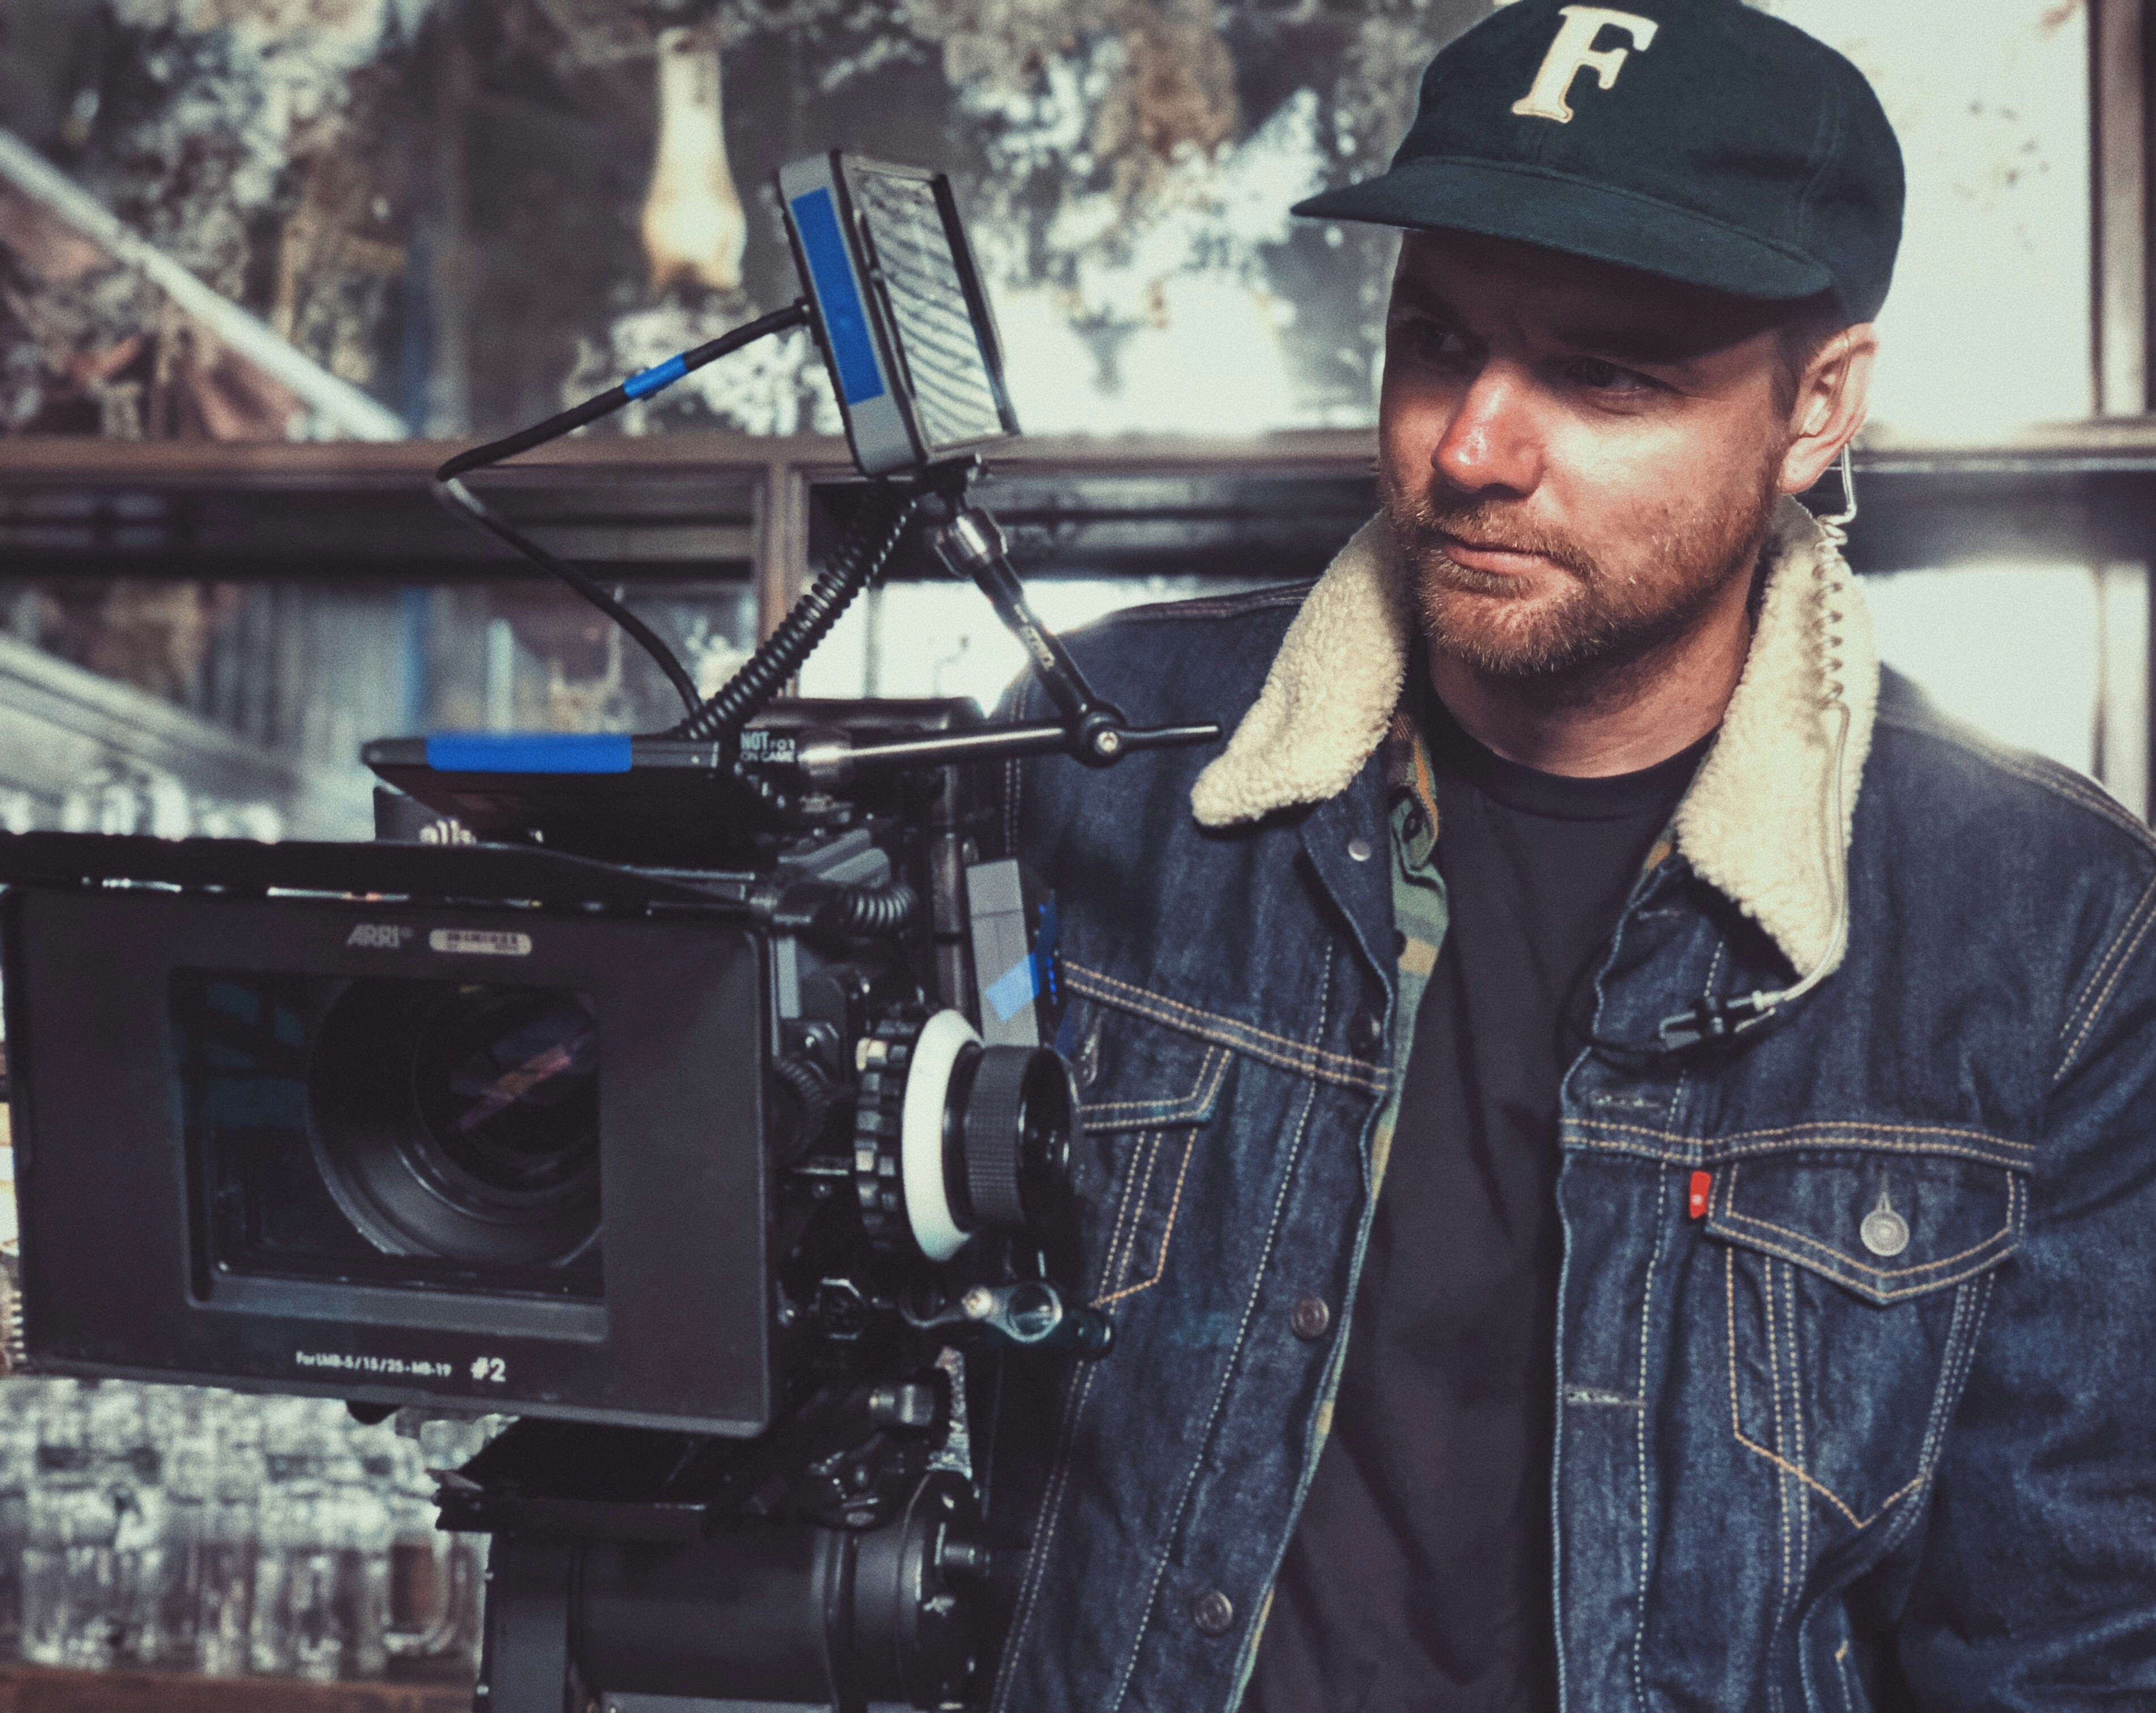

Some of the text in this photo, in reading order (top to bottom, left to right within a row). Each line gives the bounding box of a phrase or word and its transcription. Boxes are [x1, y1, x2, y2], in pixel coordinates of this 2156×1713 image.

[1511, 5, 1659, 123] F
[347, 924, 401, 948] ARRI
[470, 1357, 506, 1382] #2
